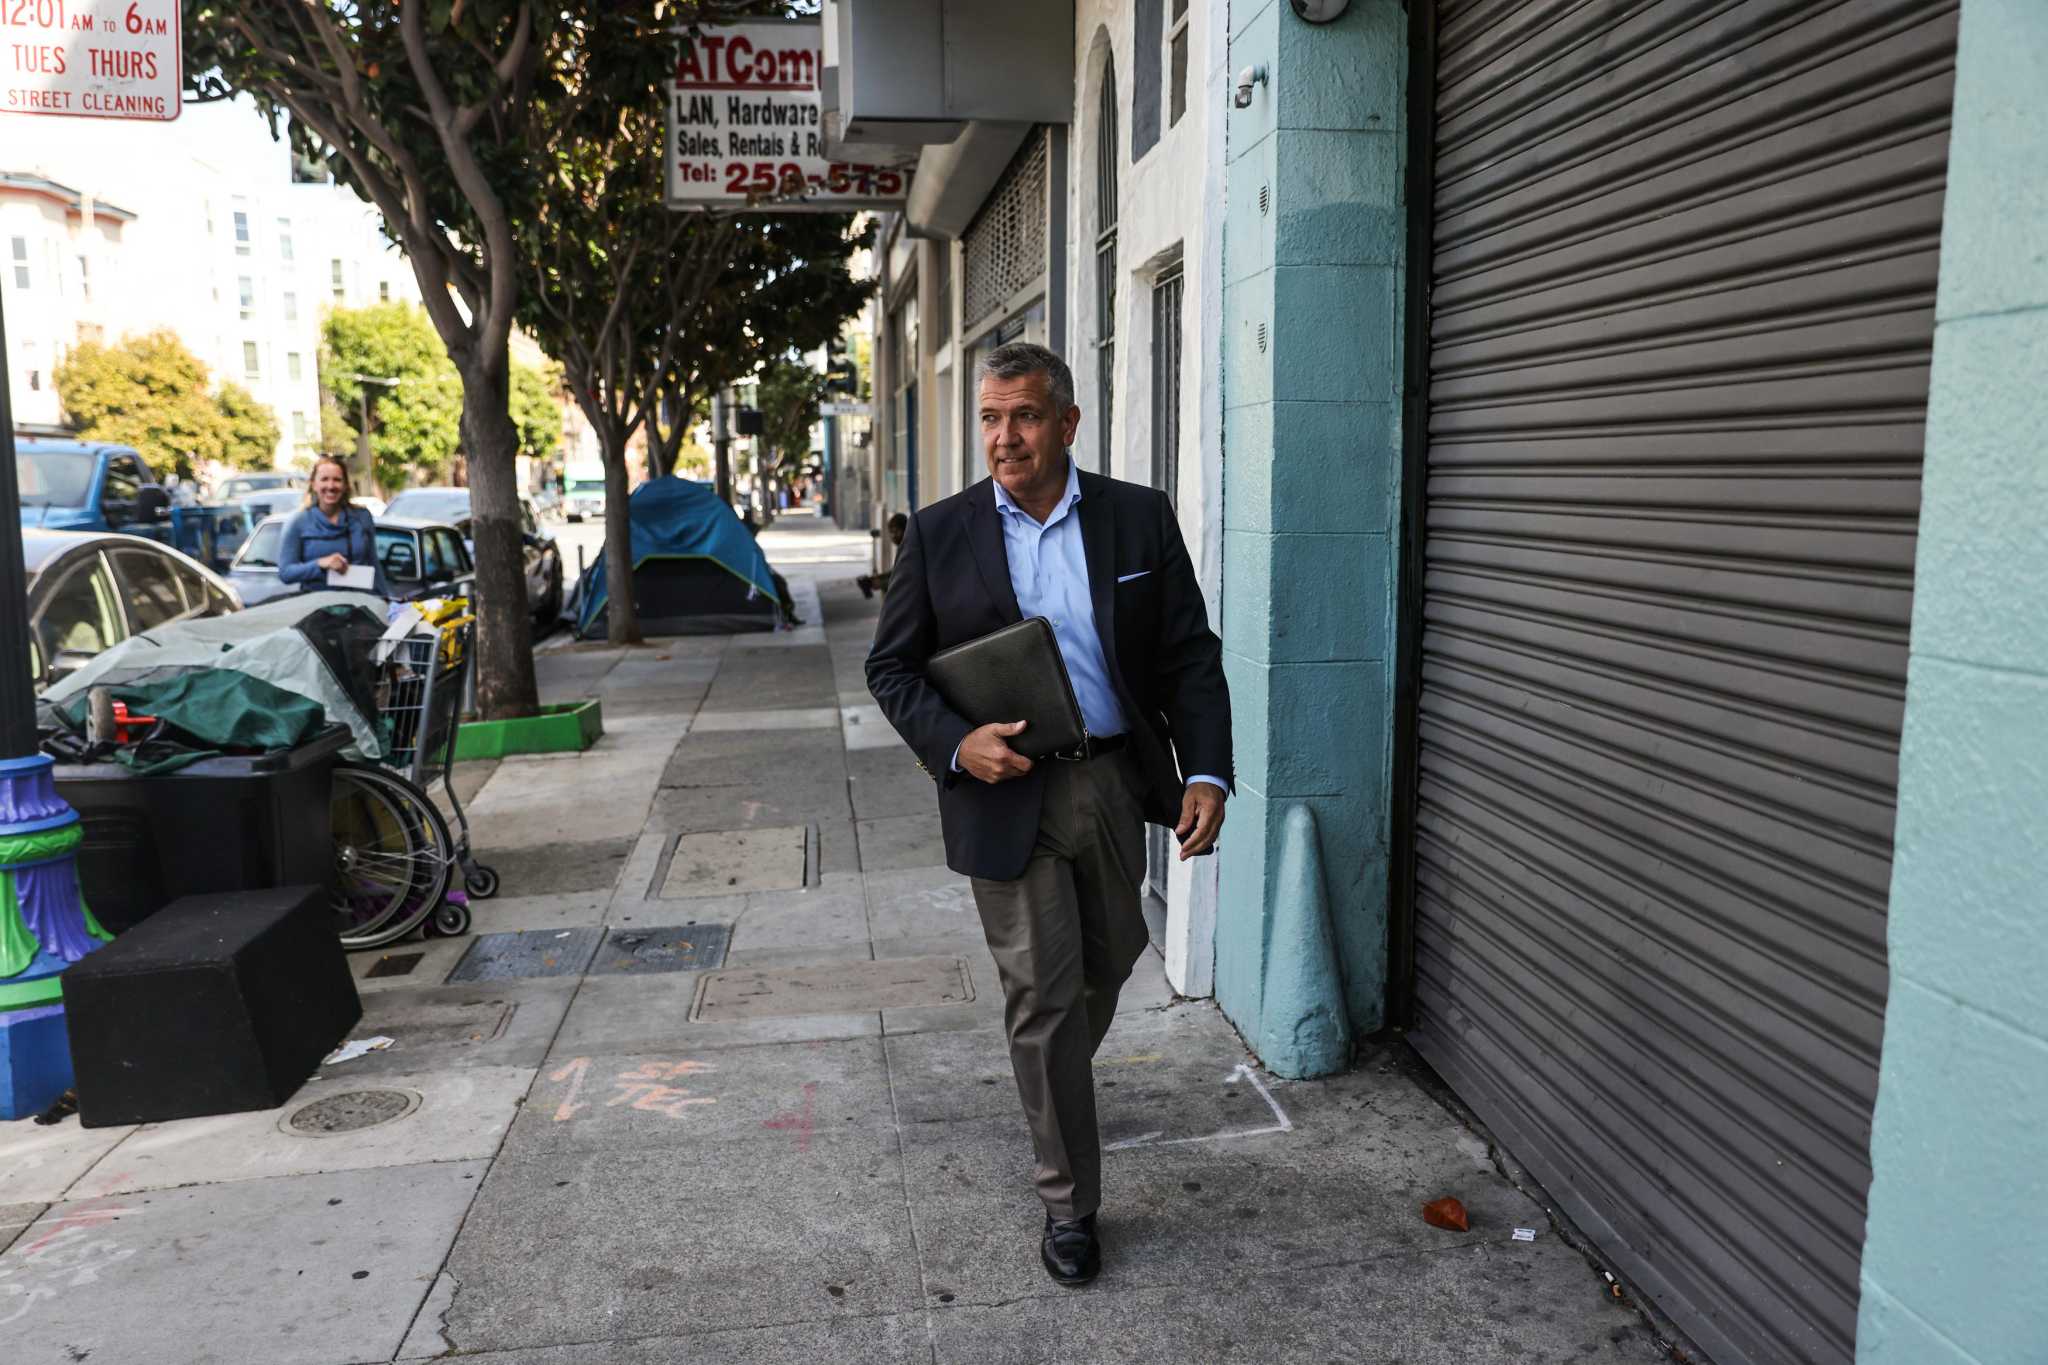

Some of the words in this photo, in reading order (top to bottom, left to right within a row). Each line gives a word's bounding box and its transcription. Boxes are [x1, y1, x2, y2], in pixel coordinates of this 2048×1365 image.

[71, 14, 94, 31] AM
[103, 20, 117, 33] TO
[12, 44, 66, 74] TUES
[88, 48, 158, 80] THURS
[7, 89, 72, 109] STREET
[82, 92, 165, 114] CLEANING
[676, 95, 719, 129] LAN,
[727, 96, 818, 126] Hardware
[677, 130, 724, 159] Sales,
[728, 131, 785, 157] Rentals
[791, 131, 801, 157] &
[679, 162, 717, 184] Tel:
